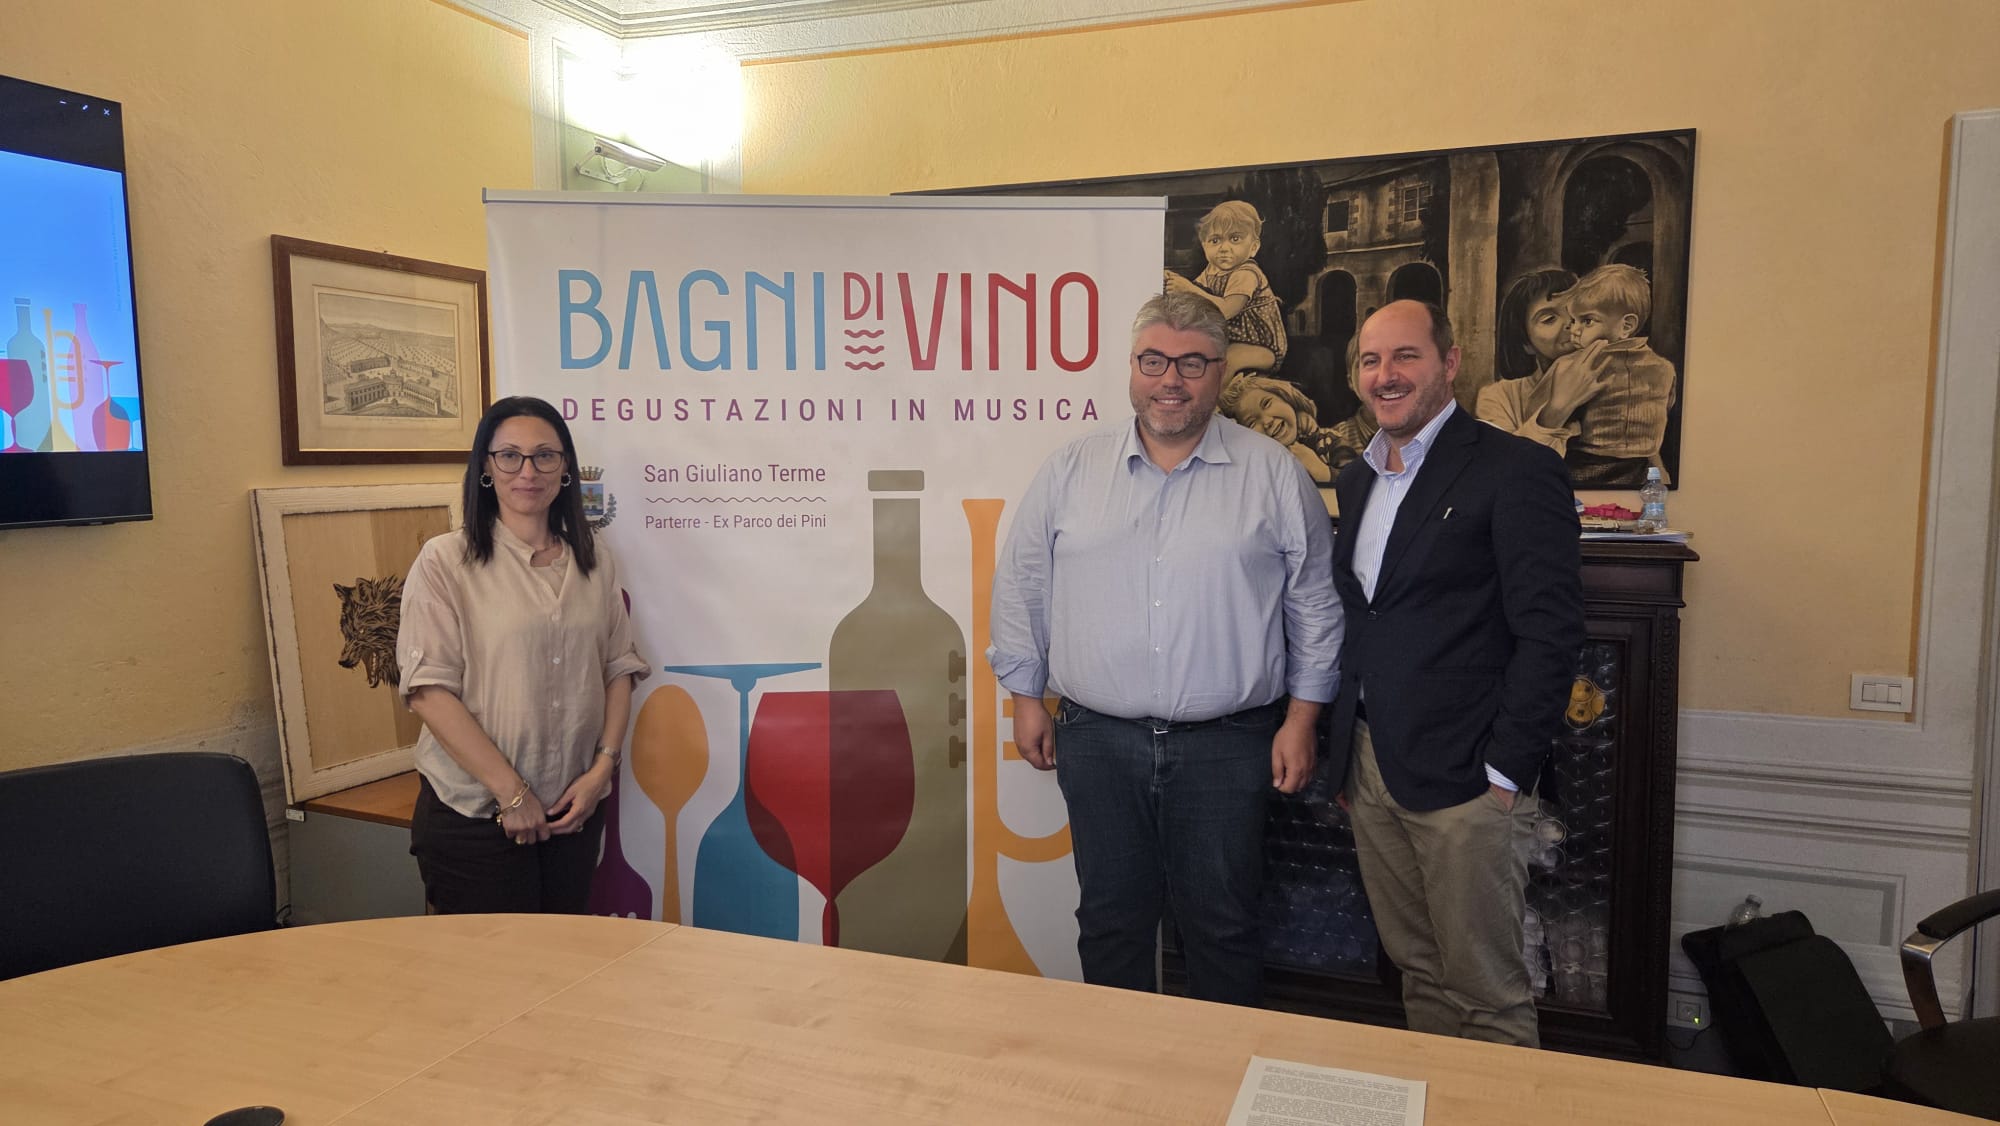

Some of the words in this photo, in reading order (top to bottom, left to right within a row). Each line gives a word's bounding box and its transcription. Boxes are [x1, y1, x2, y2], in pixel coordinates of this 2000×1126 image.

[559, 269, 826, 372] BAGNI
[842, 271, 884, 321] DI
[897, 271, 1100, 373] VINO
[562, 398, 862, 421] DEGUSTAZIONI
[890, 399, 926, 422] IN
[953, 399, 1099, 422] MUSICA
[644, 464, 679, 482] San
[686, 464, 762, 482] Giuliano
[768, 464, 826, 482] Terme
[645, 515, 701, 528] Parterre
[713, 515, 729, 528] Ex
[734, 515, 773, 528] Parco
[776, 514, 797, 528] dei
[801, 514, 826, 528] Pini
